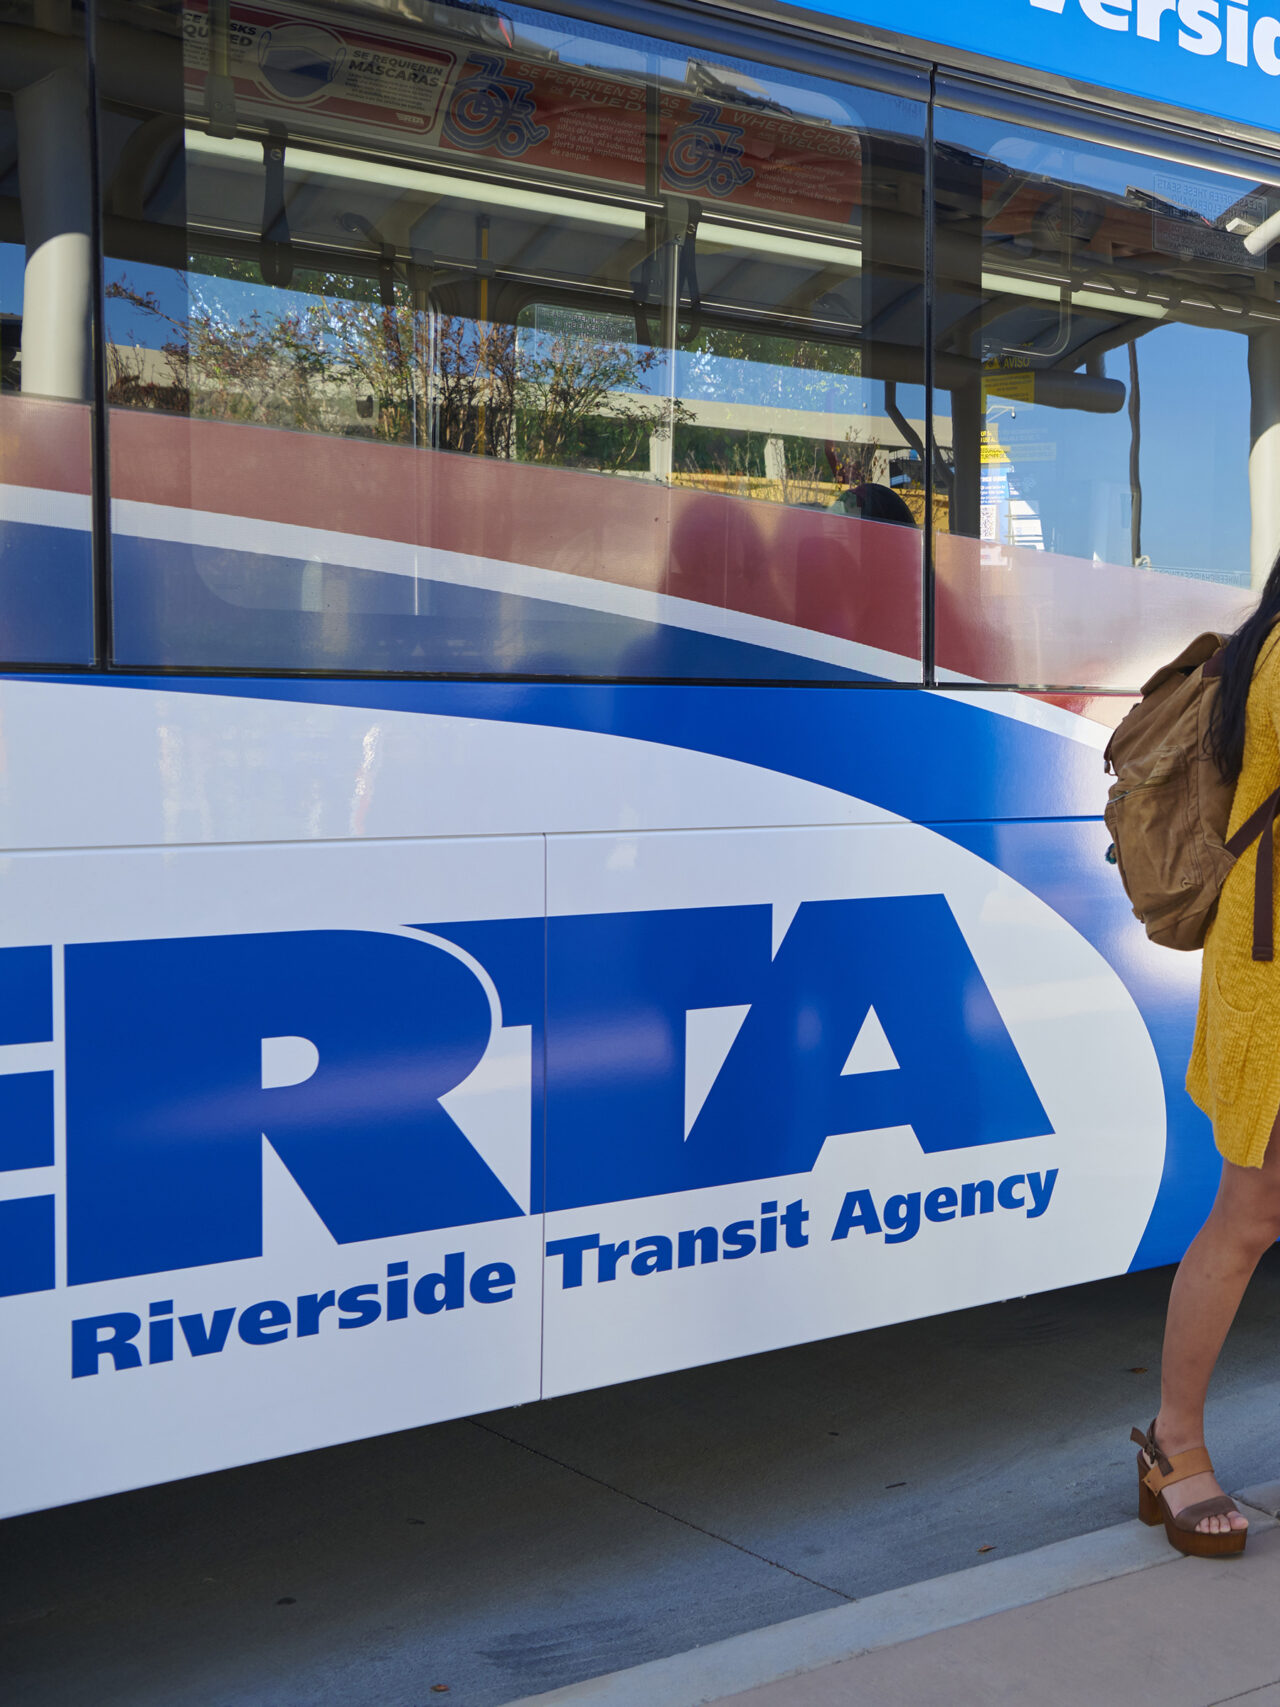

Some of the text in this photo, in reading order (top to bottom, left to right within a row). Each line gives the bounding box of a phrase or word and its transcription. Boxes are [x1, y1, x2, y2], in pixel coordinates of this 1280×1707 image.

[352, 50, 443, 76] SE REQUIEREN
[517, 63, 680, 109] SE PERMITEN SILAS
[570, 88, 674, 119] RUEDS
[733, 112, 860, 148] WHEELCHAIR
[781, 133, 862, 160] WELCOME
[72, 1168, 1059, 1378] Riverside Transit Agency
